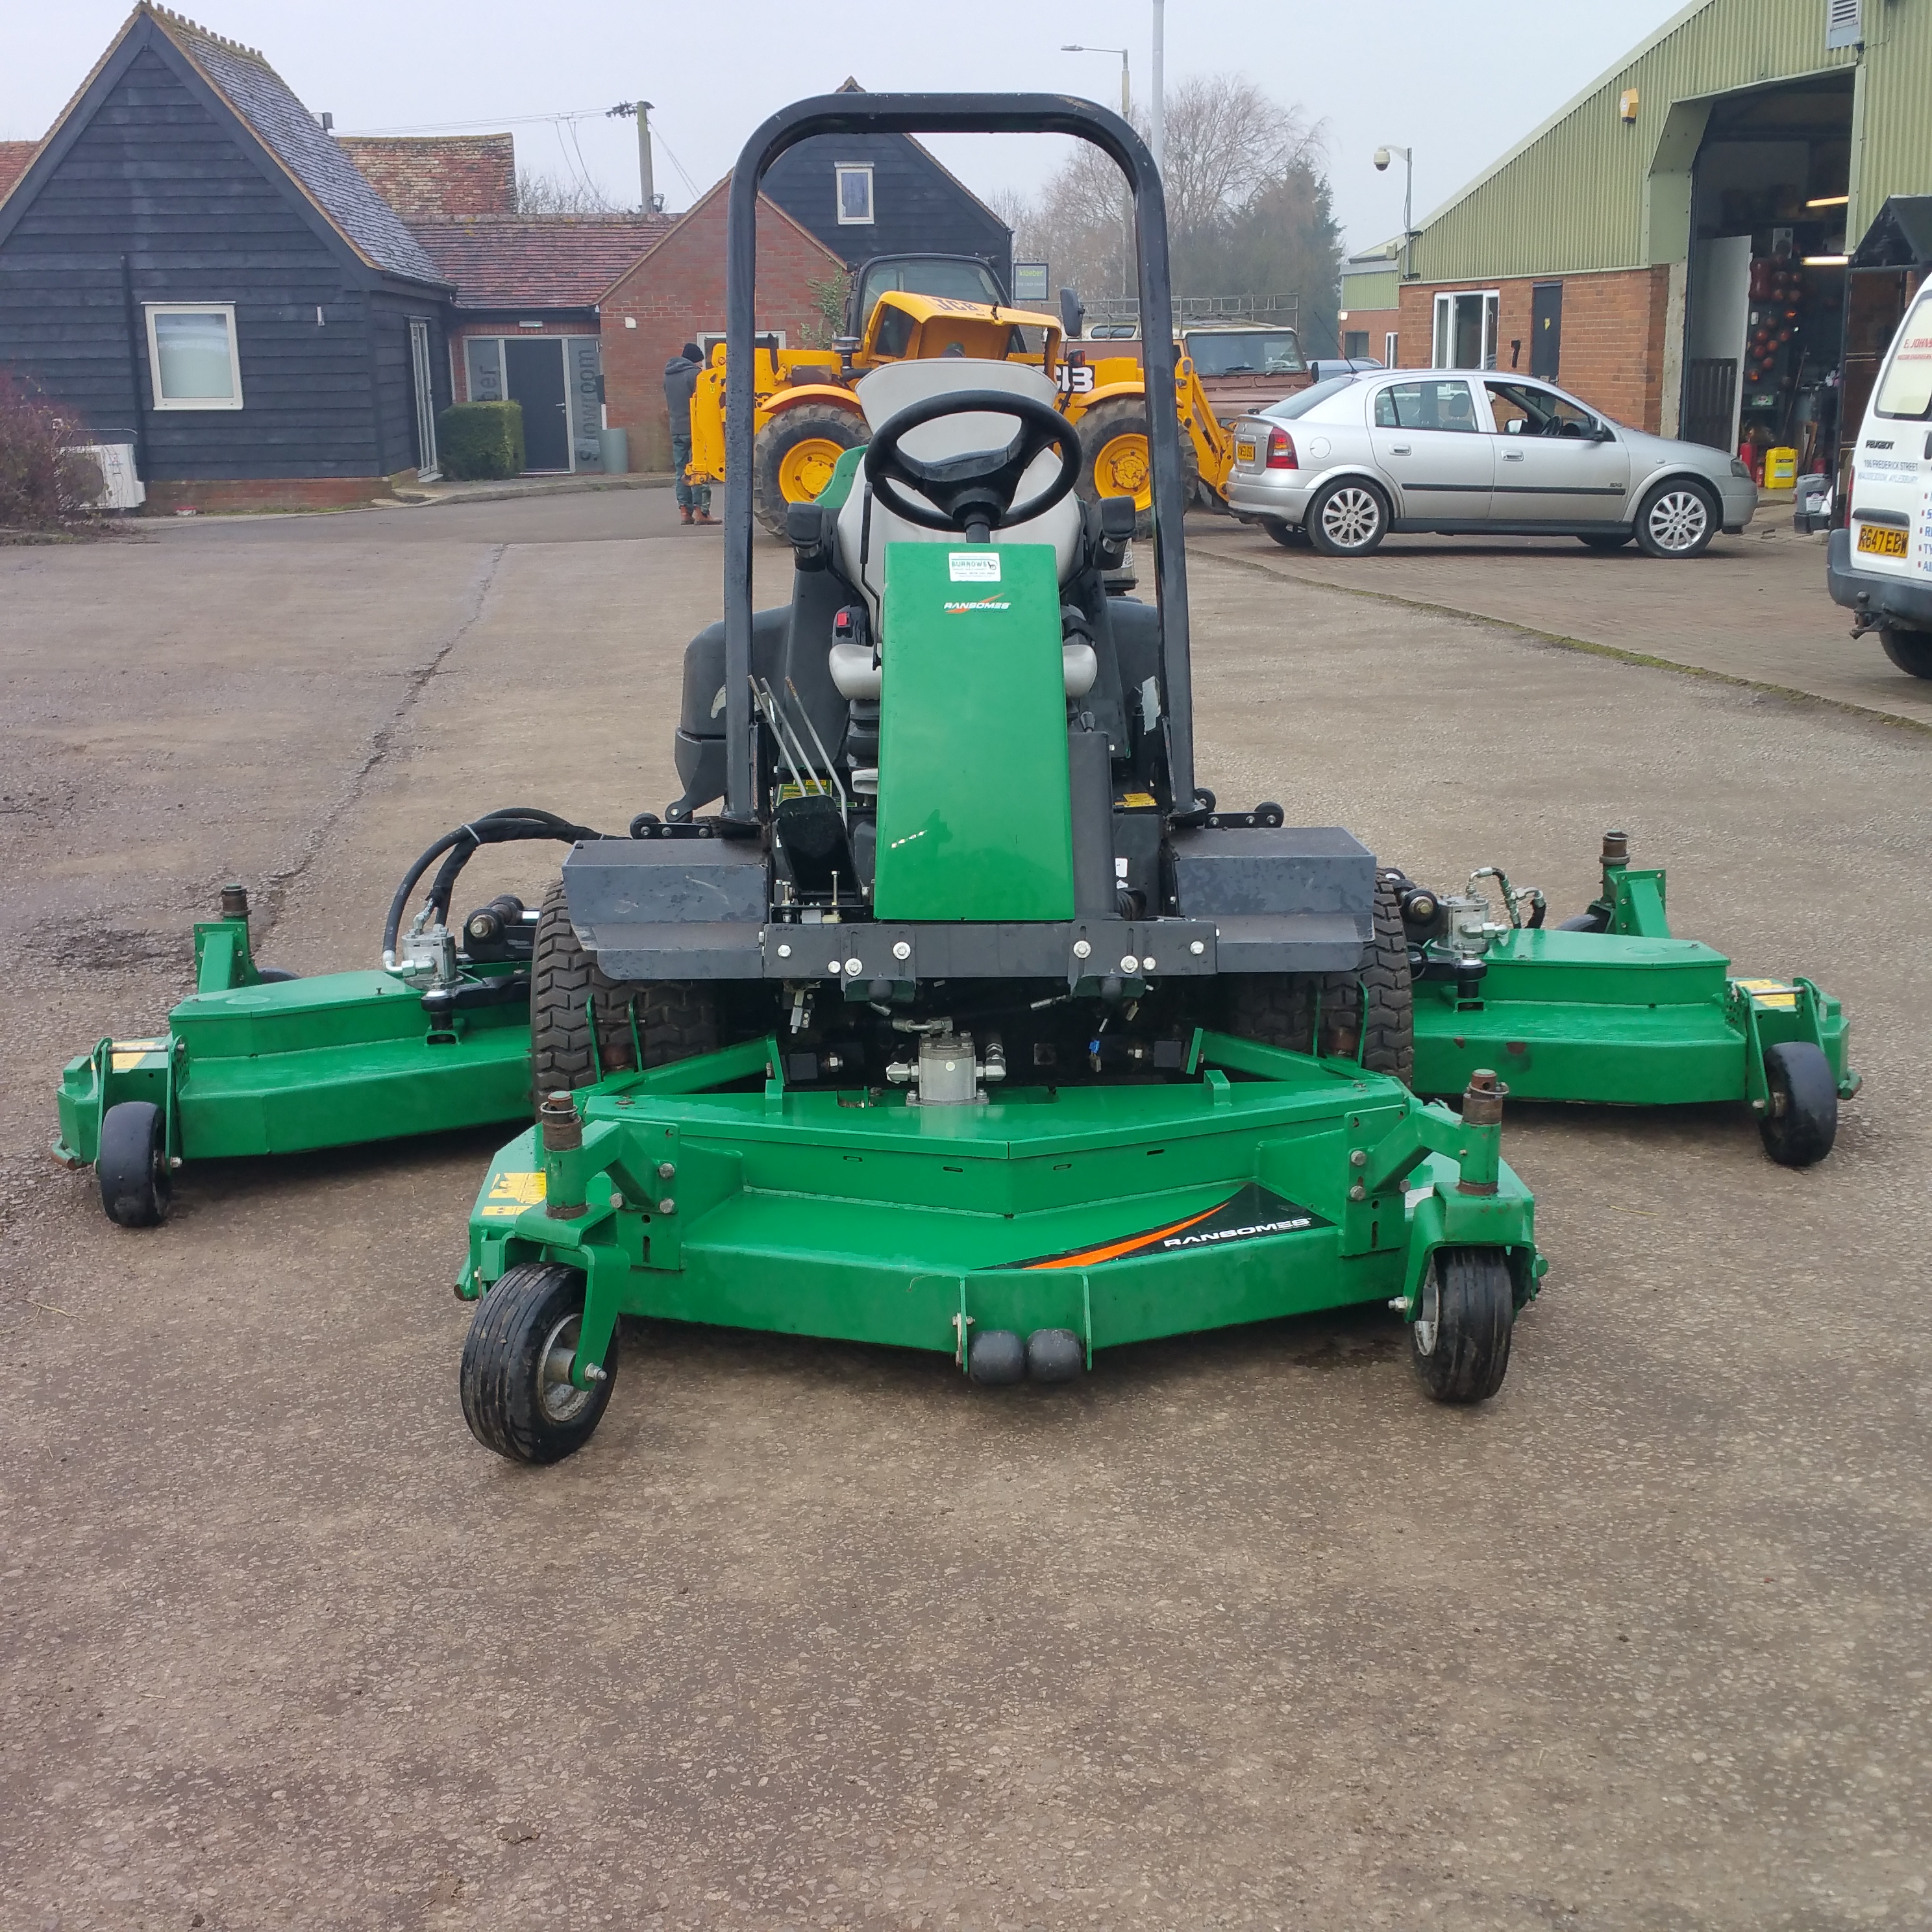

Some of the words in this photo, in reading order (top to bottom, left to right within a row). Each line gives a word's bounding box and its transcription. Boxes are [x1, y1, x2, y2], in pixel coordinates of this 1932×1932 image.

[931, 297, 980, 311] JCB
[1511, 340, 1521, 368] 7
[1865, 440, 1895, 450] PEUGEOT
[1872, 460, 1900, 469] FREDERICK
[1900, 461, 1918, 471] STREET
[1163, 1217, 1310, 1248] RANSOMES
